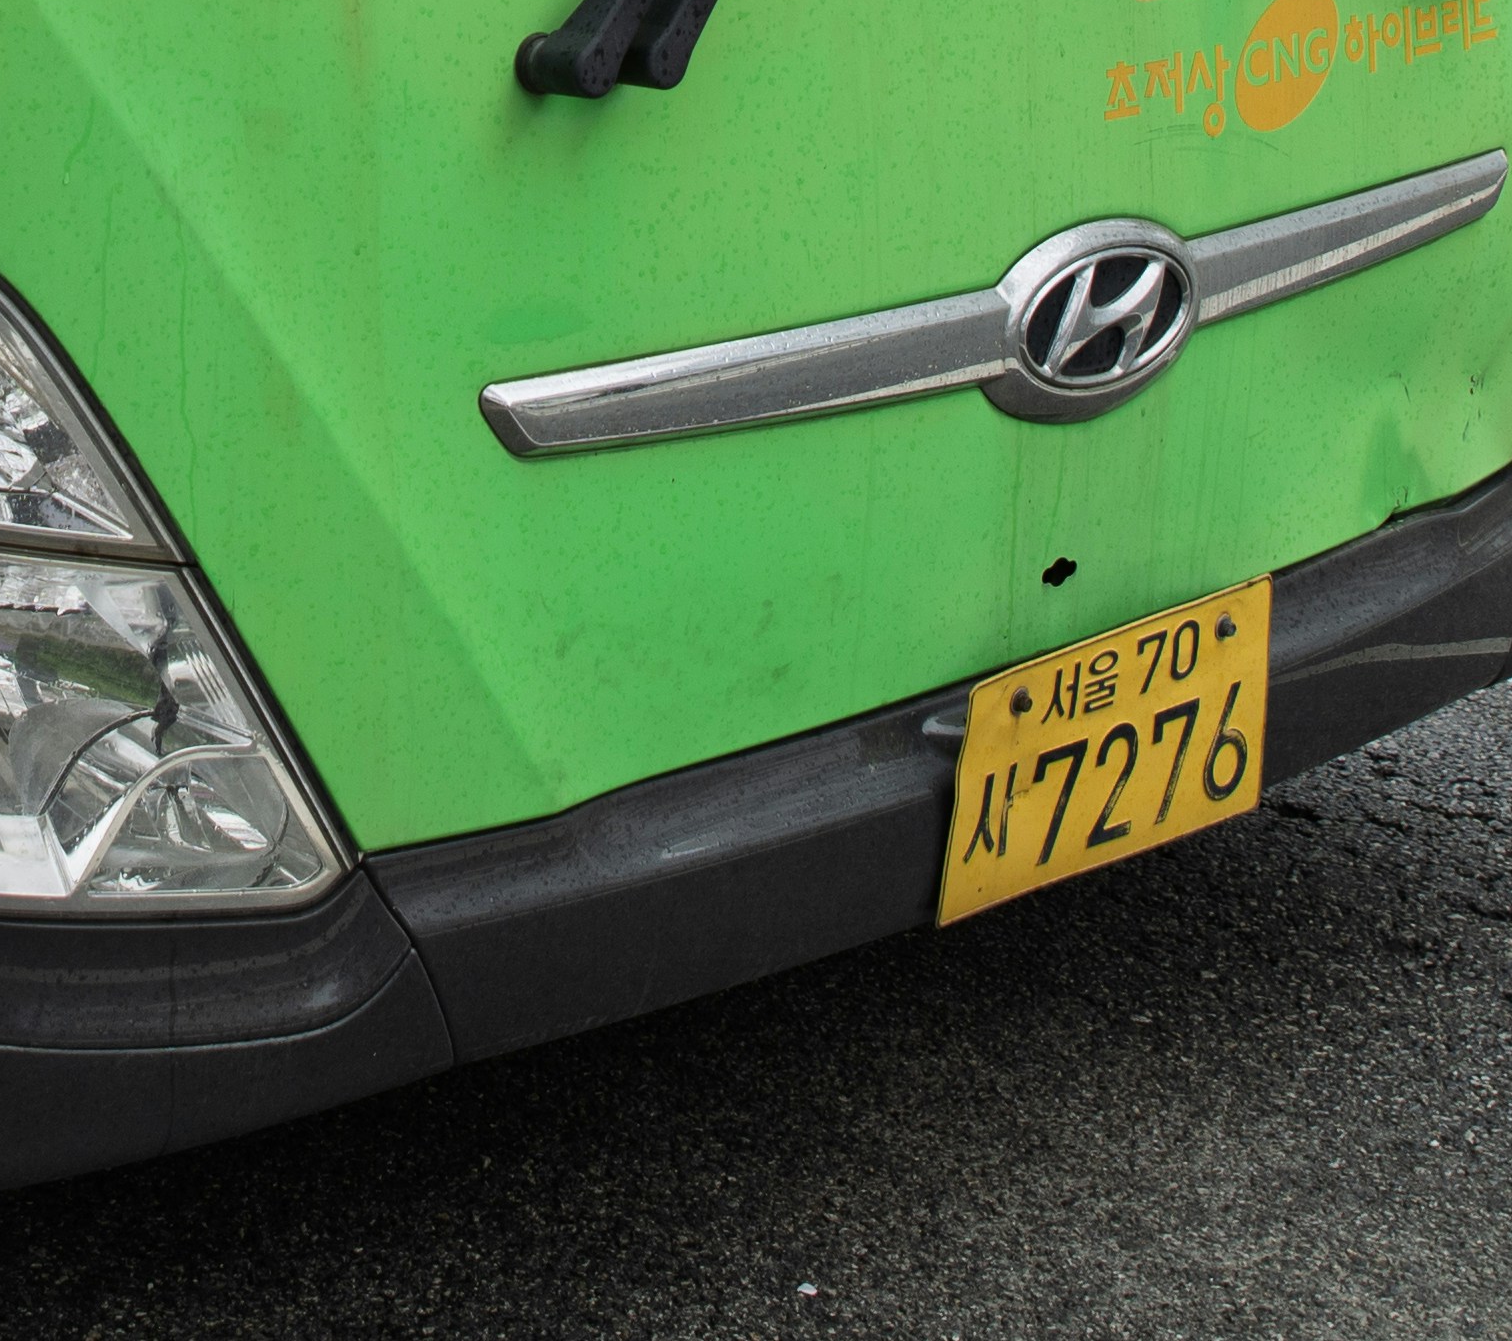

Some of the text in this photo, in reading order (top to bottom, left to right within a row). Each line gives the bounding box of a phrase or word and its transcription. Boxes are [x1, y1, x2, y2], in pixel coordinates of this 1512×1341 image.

[1103, 42, 1232, 139] 초저상
[1243, 27, 1332, 87] CNG
[1040, 618, 1202, 725] 서울 70
